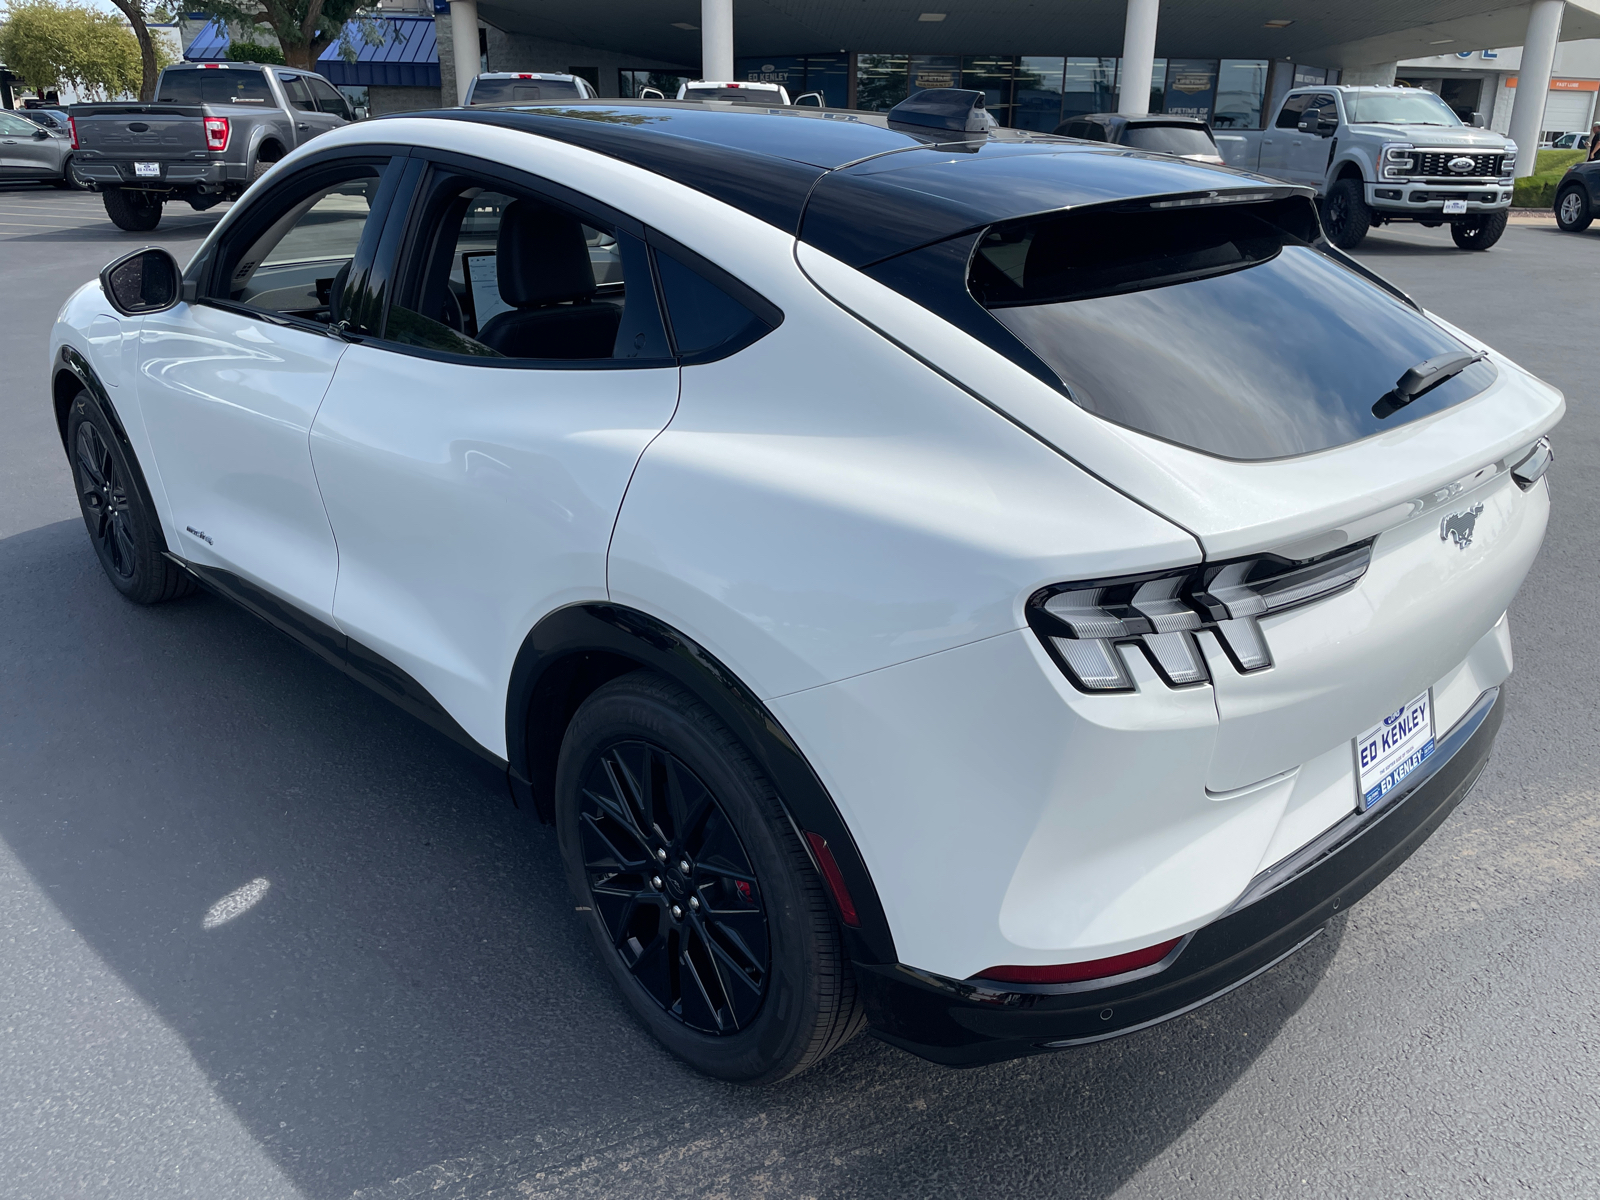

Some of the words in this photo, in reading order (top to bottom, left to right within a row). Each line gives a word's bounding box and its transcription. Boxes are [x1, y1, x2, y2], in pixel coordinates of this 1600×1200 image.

[760, 73, 788, 81] KENLEY
[1360, 740, 1378, 769] ED
[1381, 702, 1427, 754] KENLEY
[1380, 775, 1393, 794] ED
[1393, 749, 1423, 781] KENLEY
